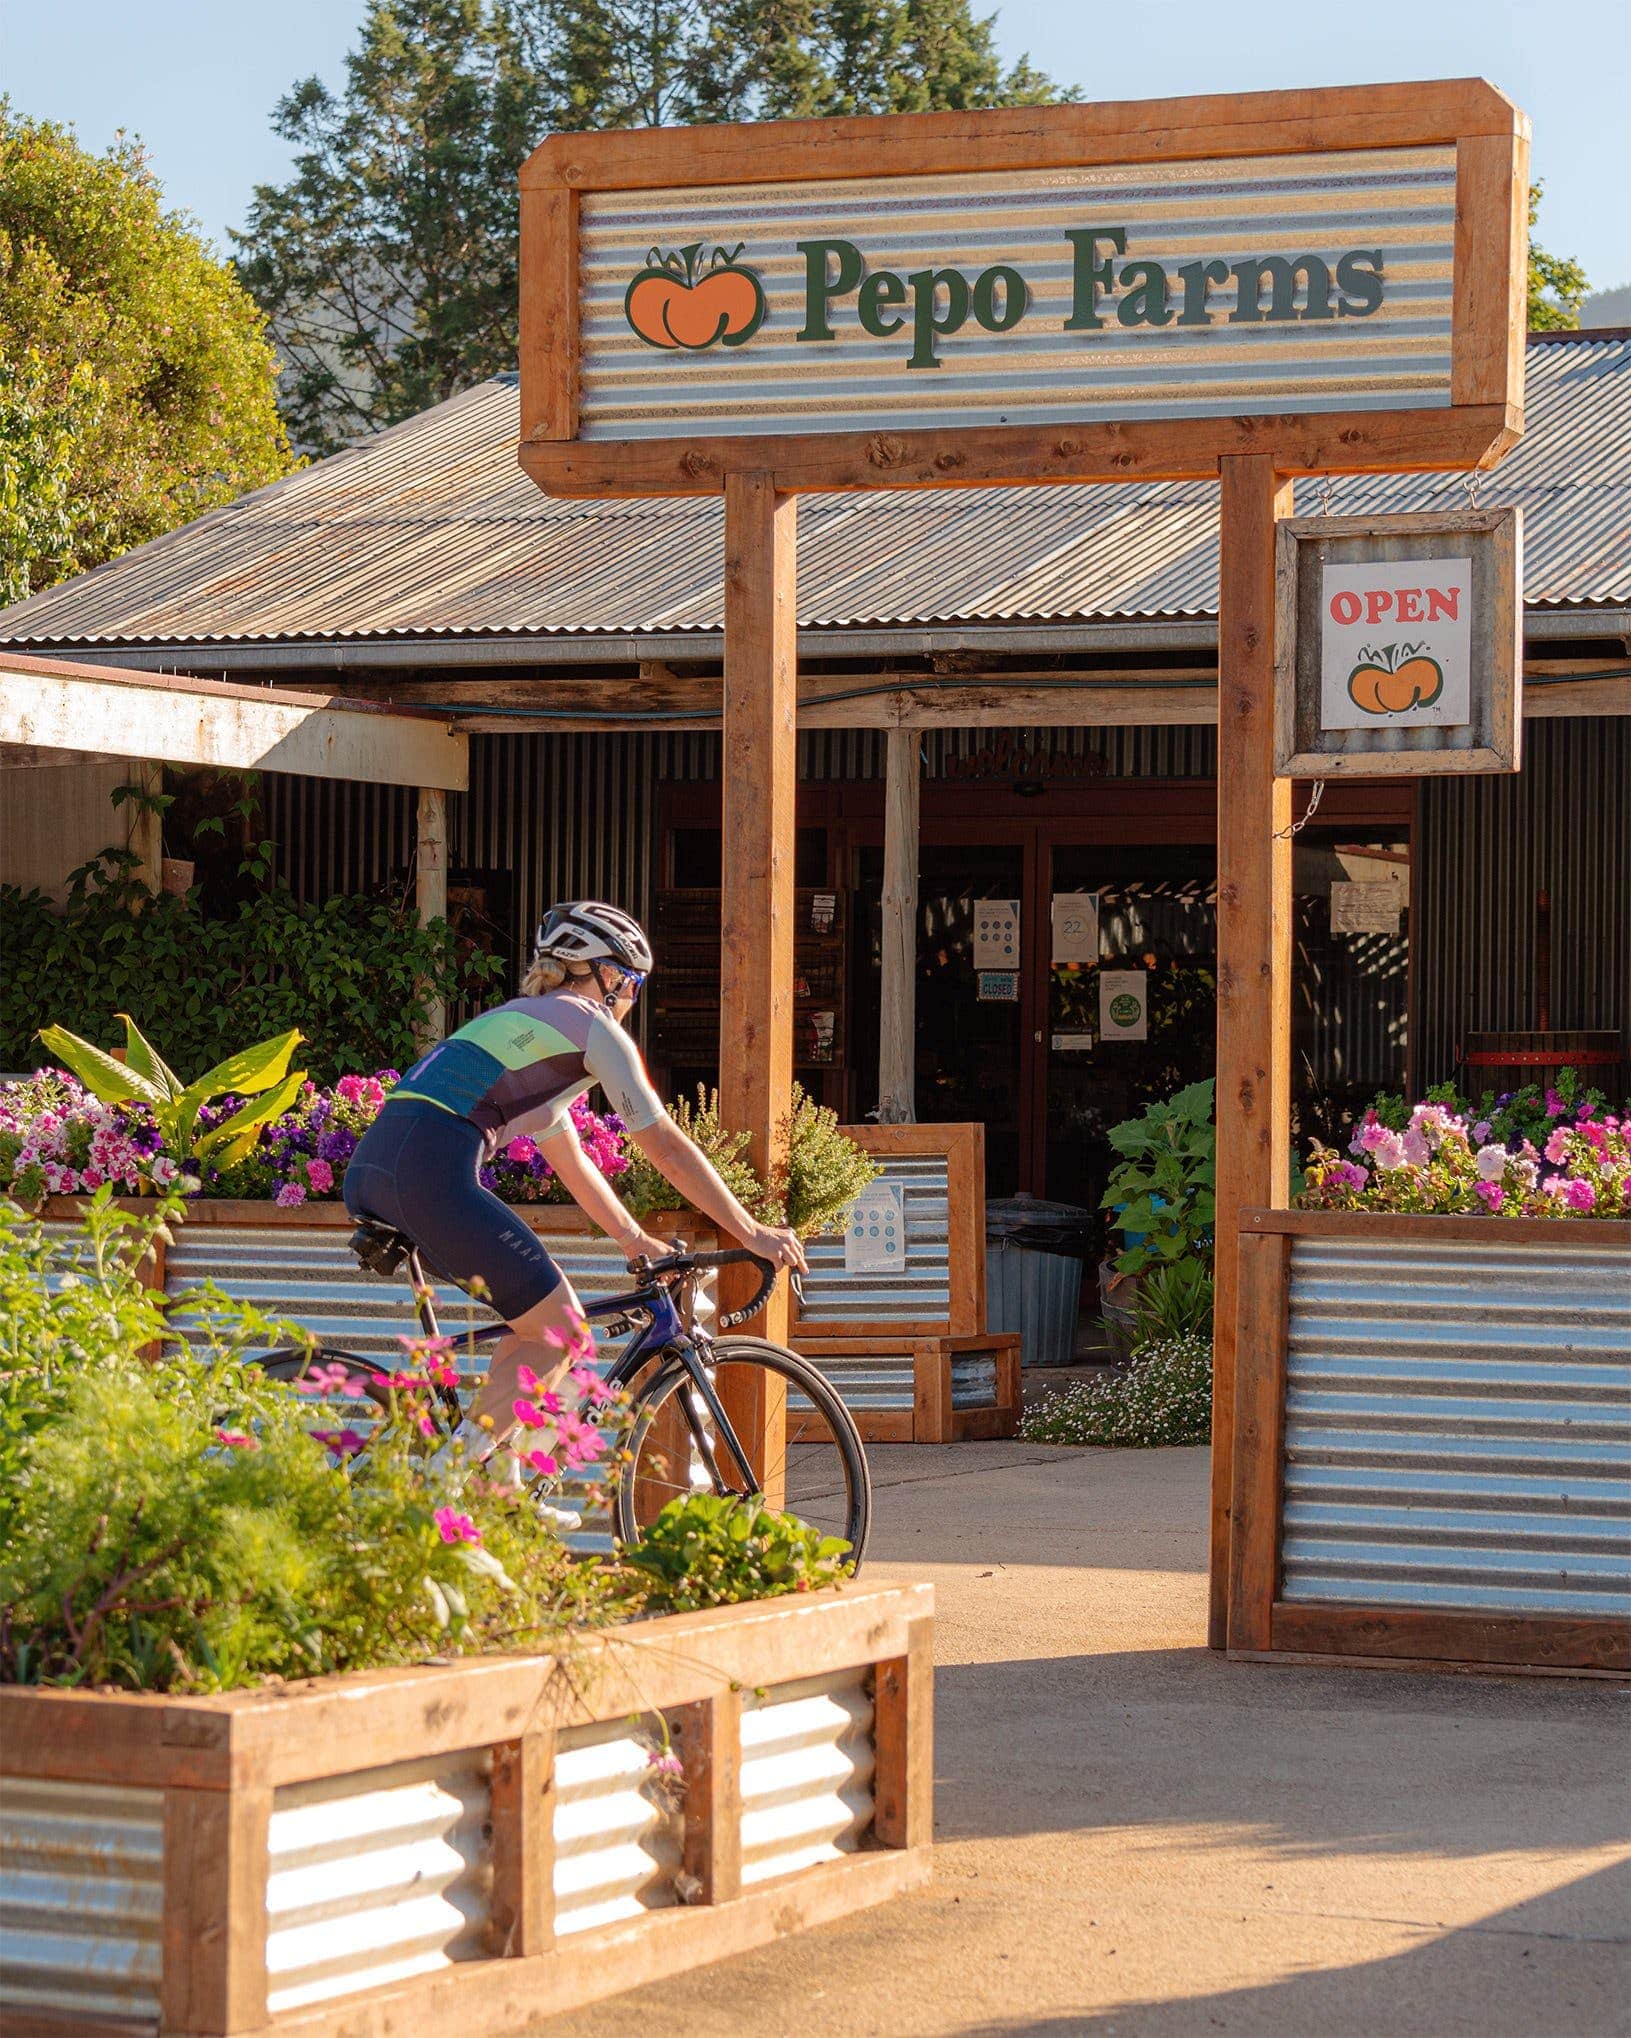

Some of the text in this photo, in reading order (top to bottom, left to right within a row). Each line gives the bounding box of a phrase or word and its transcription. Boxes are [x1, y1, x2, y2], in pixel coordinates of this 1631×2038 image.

[796, 226, 1385, 369] Pepo Farms
[1329, 586, 1461, 626] OPEN
[981, 983, 1012, 996] CLOSED
[498, 1230, 542, 1263] MAAP
